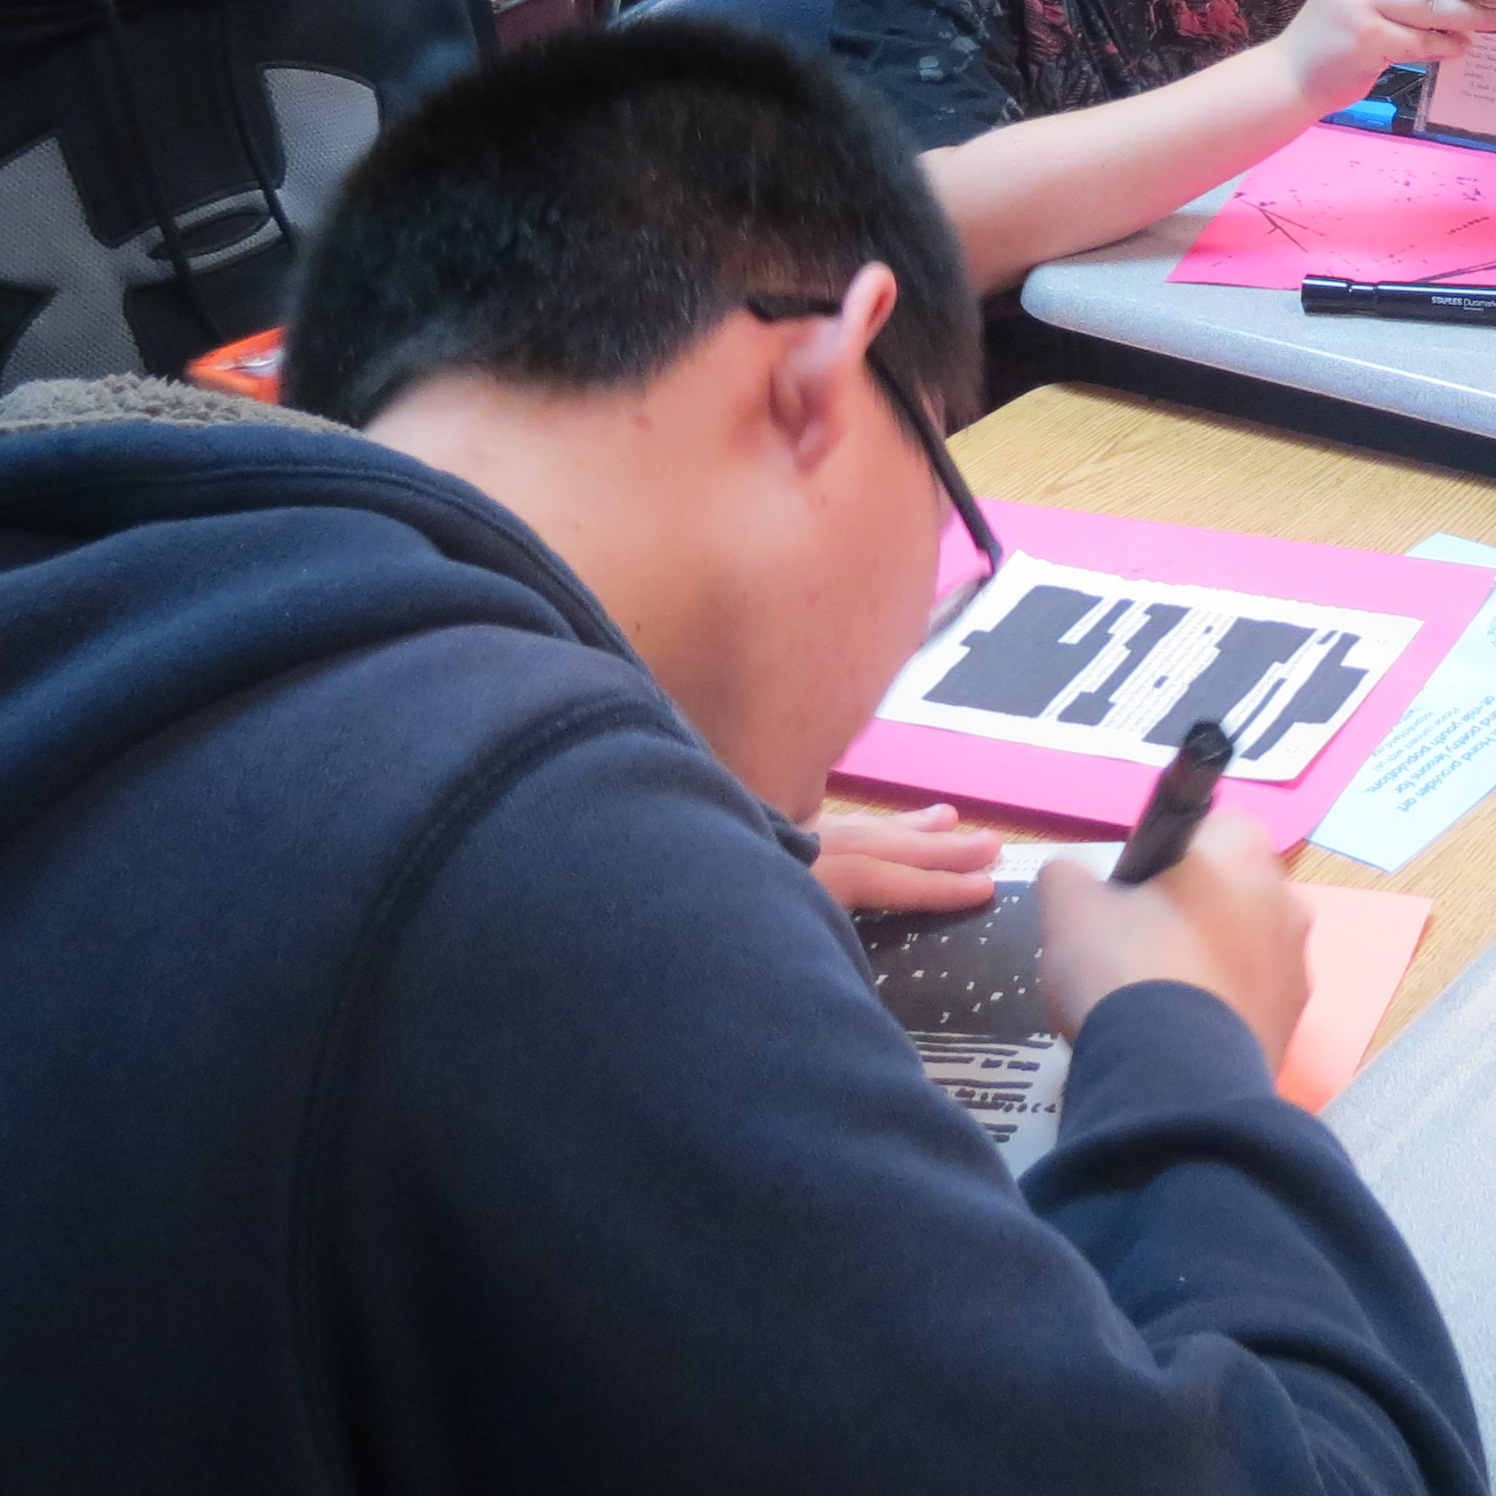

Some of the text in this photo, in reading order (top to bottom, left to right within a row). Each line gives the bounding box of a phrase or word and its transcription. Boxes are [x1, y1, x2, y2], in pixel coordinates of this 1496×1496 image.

[1431, 296, 1463, 307] STAPLES
[1430, 721, 1462, 746] youth
[1446, 725, 1482, 752] poetry
[1461, 737, 1496, 761] Hand
[1395, 780, 1416, 794] for
[1416, 759, 1462, 796] provides
[1396, 797, 1417, 812] art
